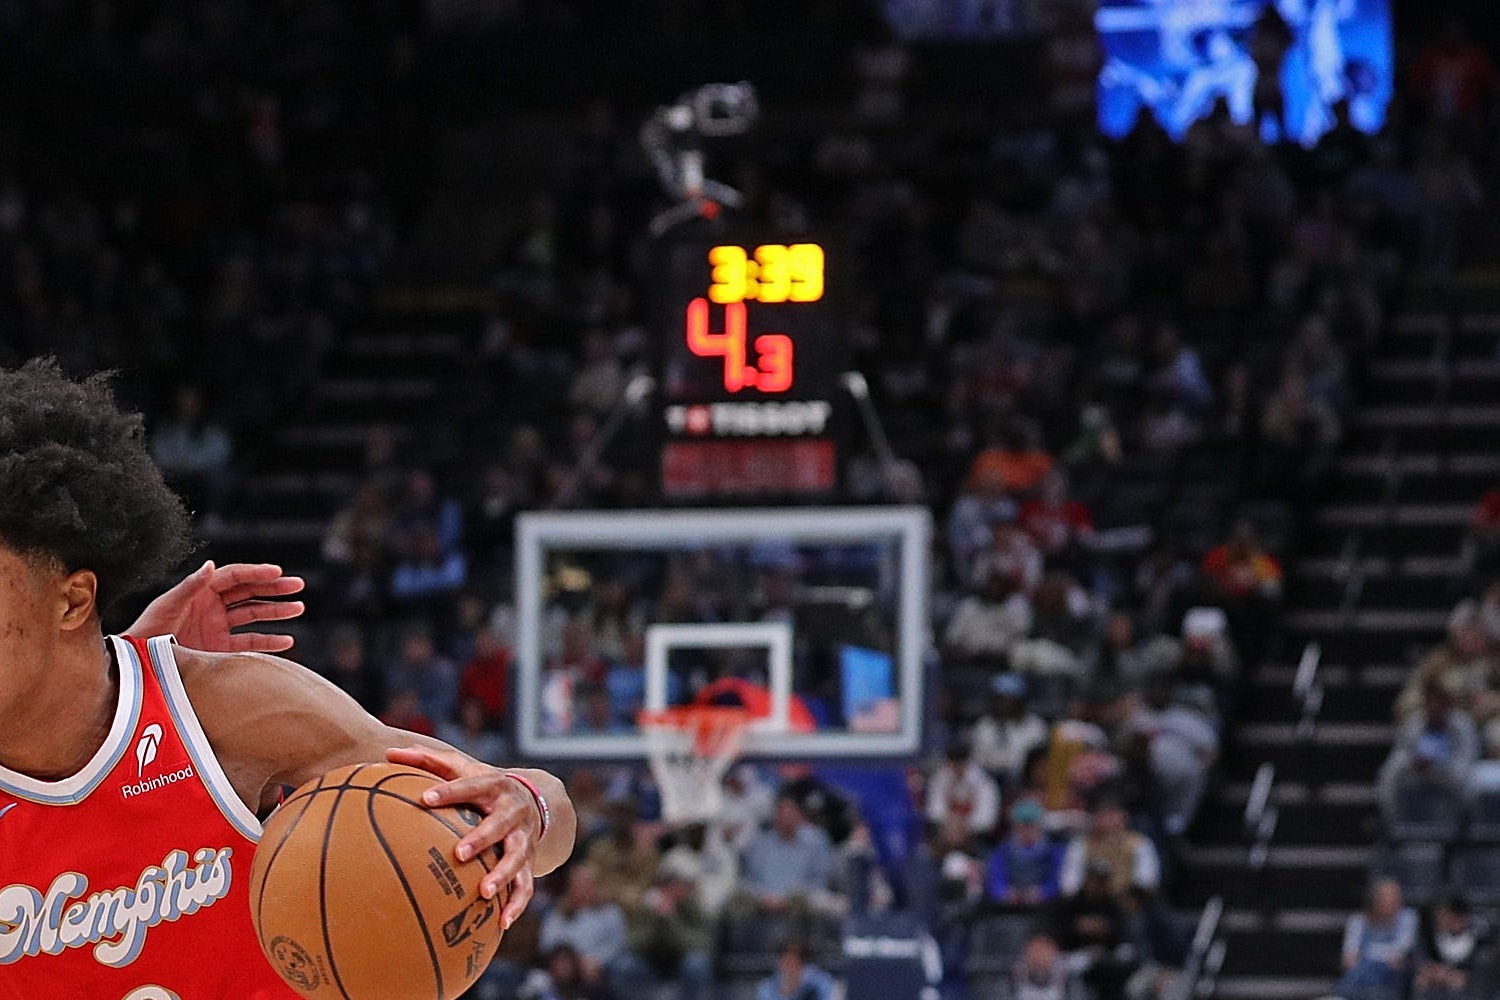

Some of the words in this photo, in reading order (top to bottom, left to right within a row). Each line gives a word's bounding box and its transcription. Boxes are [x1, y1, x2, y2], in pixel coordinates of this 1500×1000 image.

[708, 243, 825, 303] 3:39
[686, 297, 793, 393] 4.3
[121, 764, 194, 799] Robinhood
